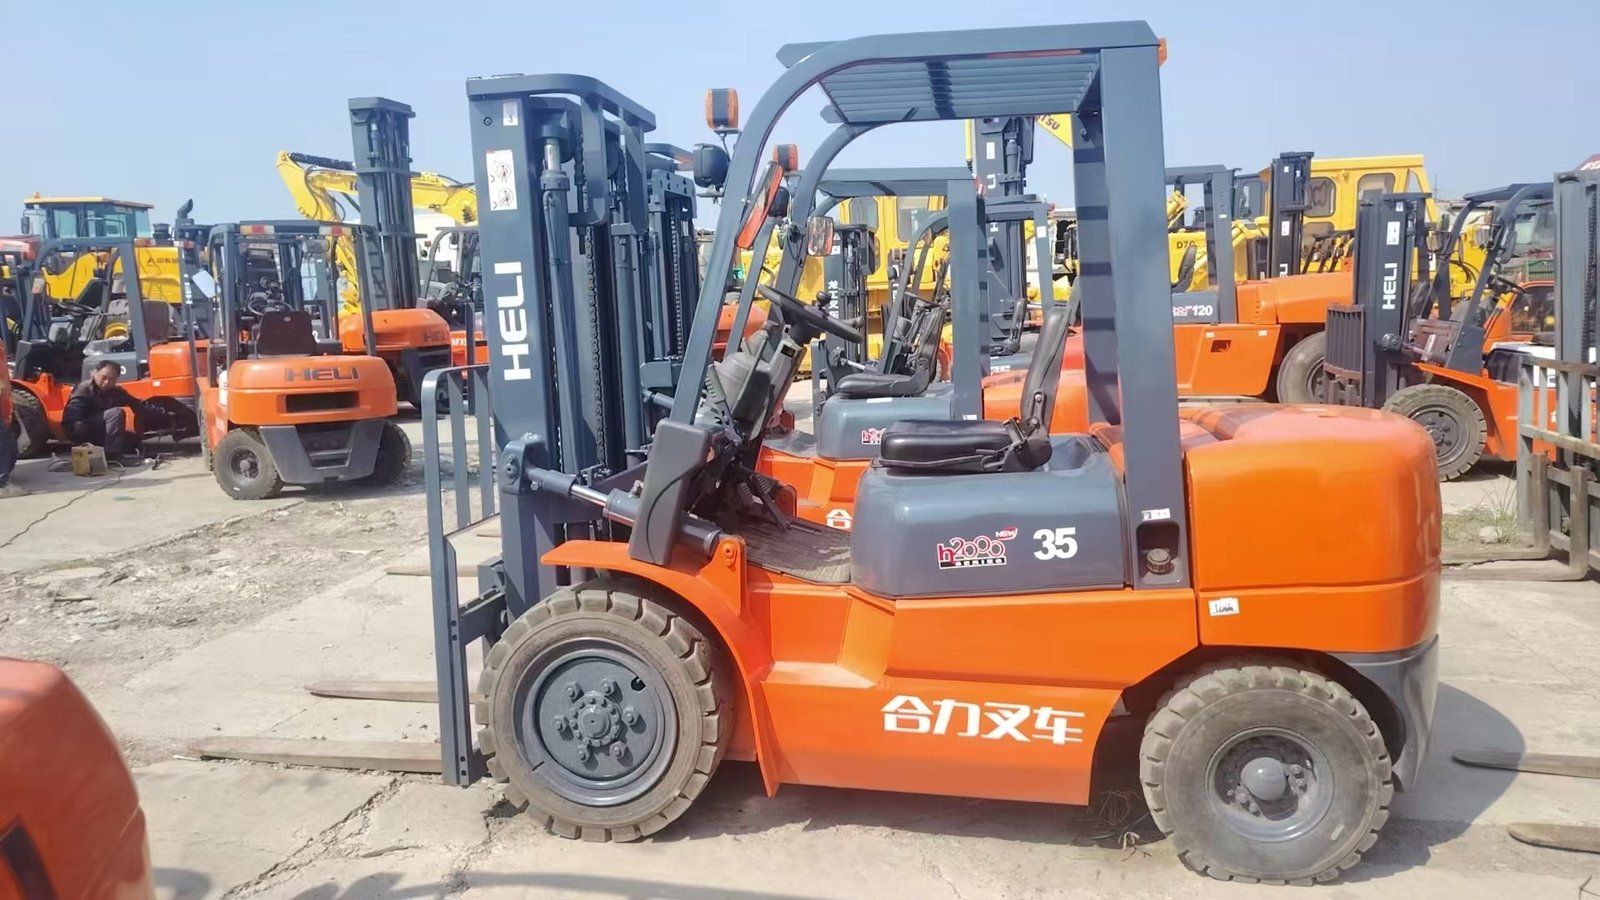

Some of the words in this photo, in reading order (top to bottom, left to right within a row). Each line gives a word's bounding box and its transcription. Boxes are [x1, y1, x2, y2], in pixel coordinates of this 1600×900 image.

[1382, 263, 1398, 309] HELI
[494, 262, 531, 380] HELI
[1192, 304, 1213, 316] 120
[286, 367, 359, 382] HELI
[937, 536, 1005, 563] h2000
[1033, 527, 1078, 560] 35
[880, 694, 1086, 745] 合力叉车
